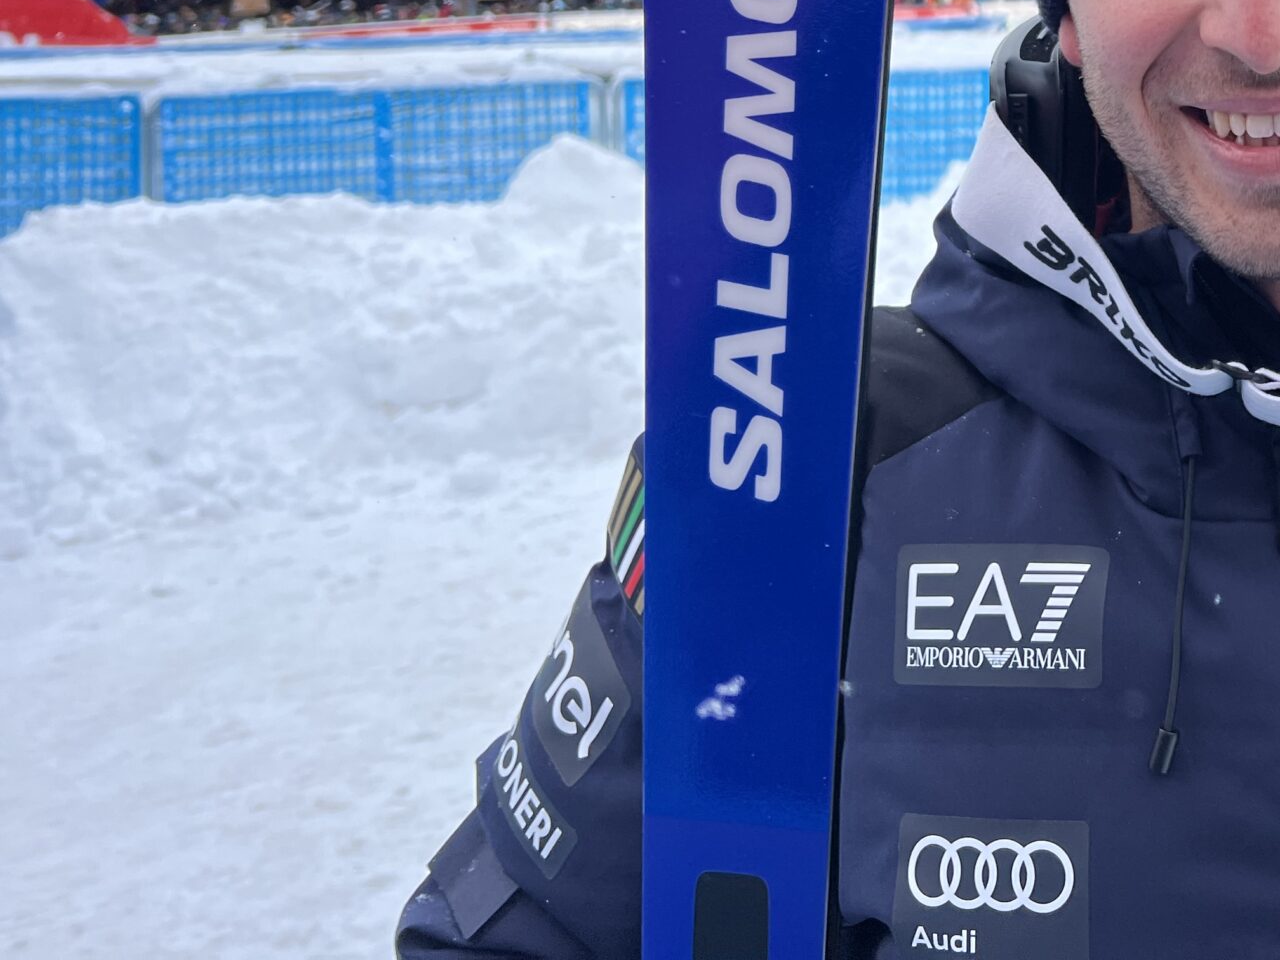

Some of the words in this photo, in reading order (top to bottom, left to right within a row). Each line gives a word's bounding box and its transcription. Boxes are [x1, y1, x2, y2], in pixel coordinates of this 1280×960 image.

[906, 562, 1092, 642] EA7
[544, 630, 614, 760] nel
[906, 646, 984, 668] EMPORIO
[1008, 647, 1086, 670] ARMANI
[497, 739, 563, 860] ONERI
[911, 925, 977, 954] Audi
